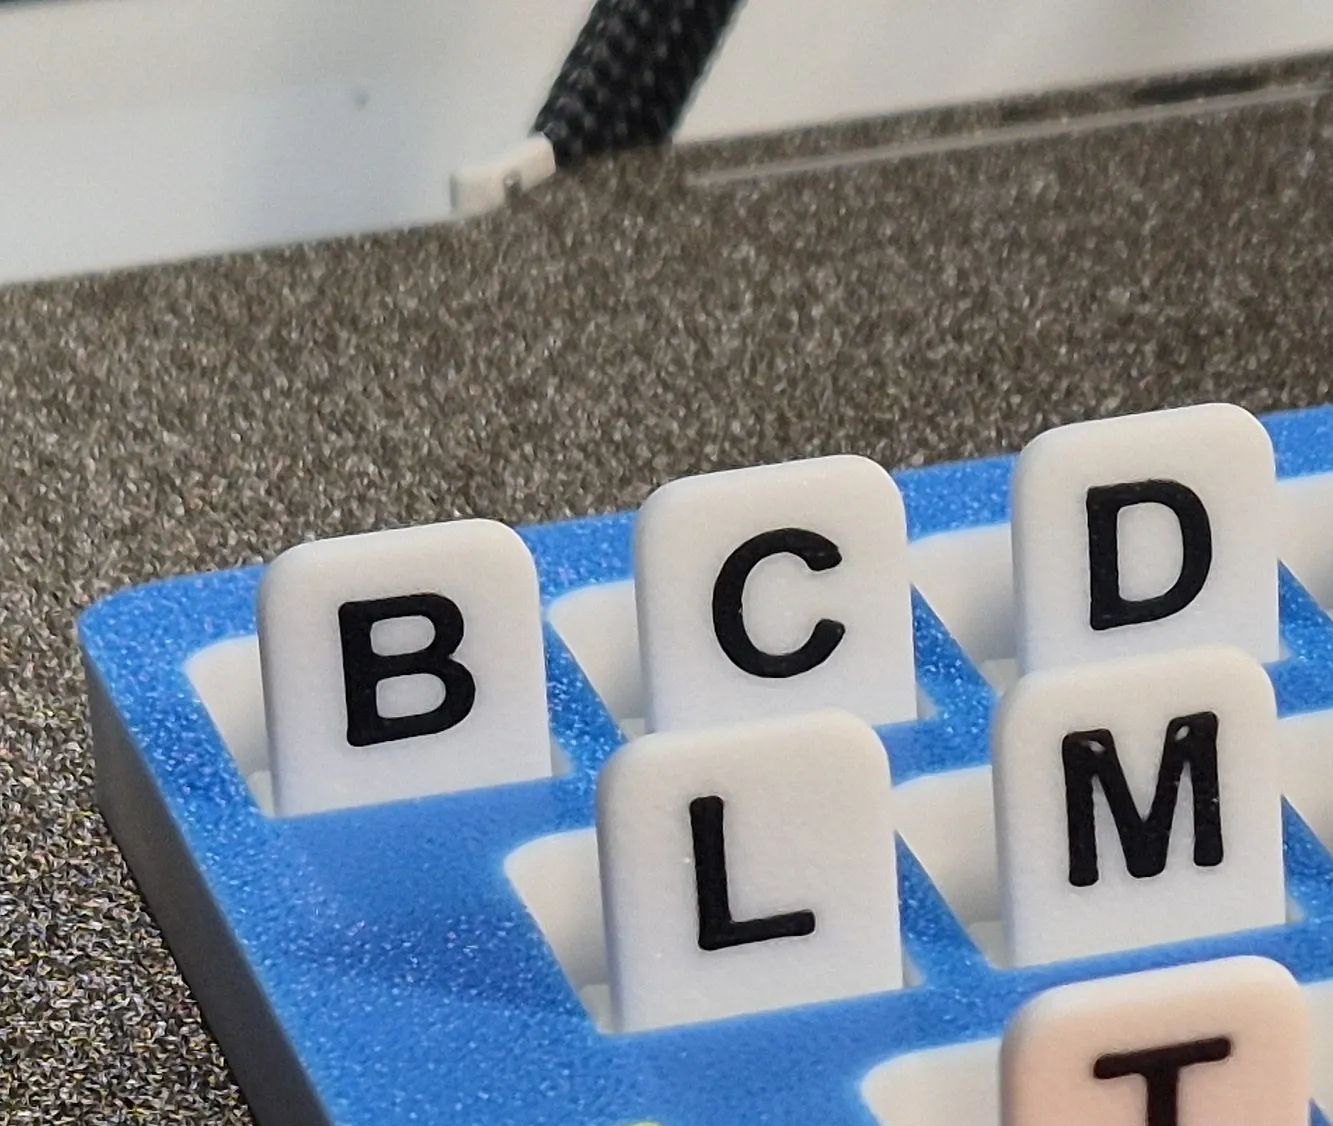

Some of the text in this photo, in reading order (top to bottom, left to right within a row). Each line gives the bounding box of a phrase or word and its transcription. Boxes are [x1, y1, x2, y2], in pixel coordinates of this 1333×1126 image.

[336, 591, 478, 749] B
[710, 526, 847, 680] C
[1084, 478, 1214, 632] D
[687, 794, 817, 953] L
[1060, 710, 1225, 889] M
